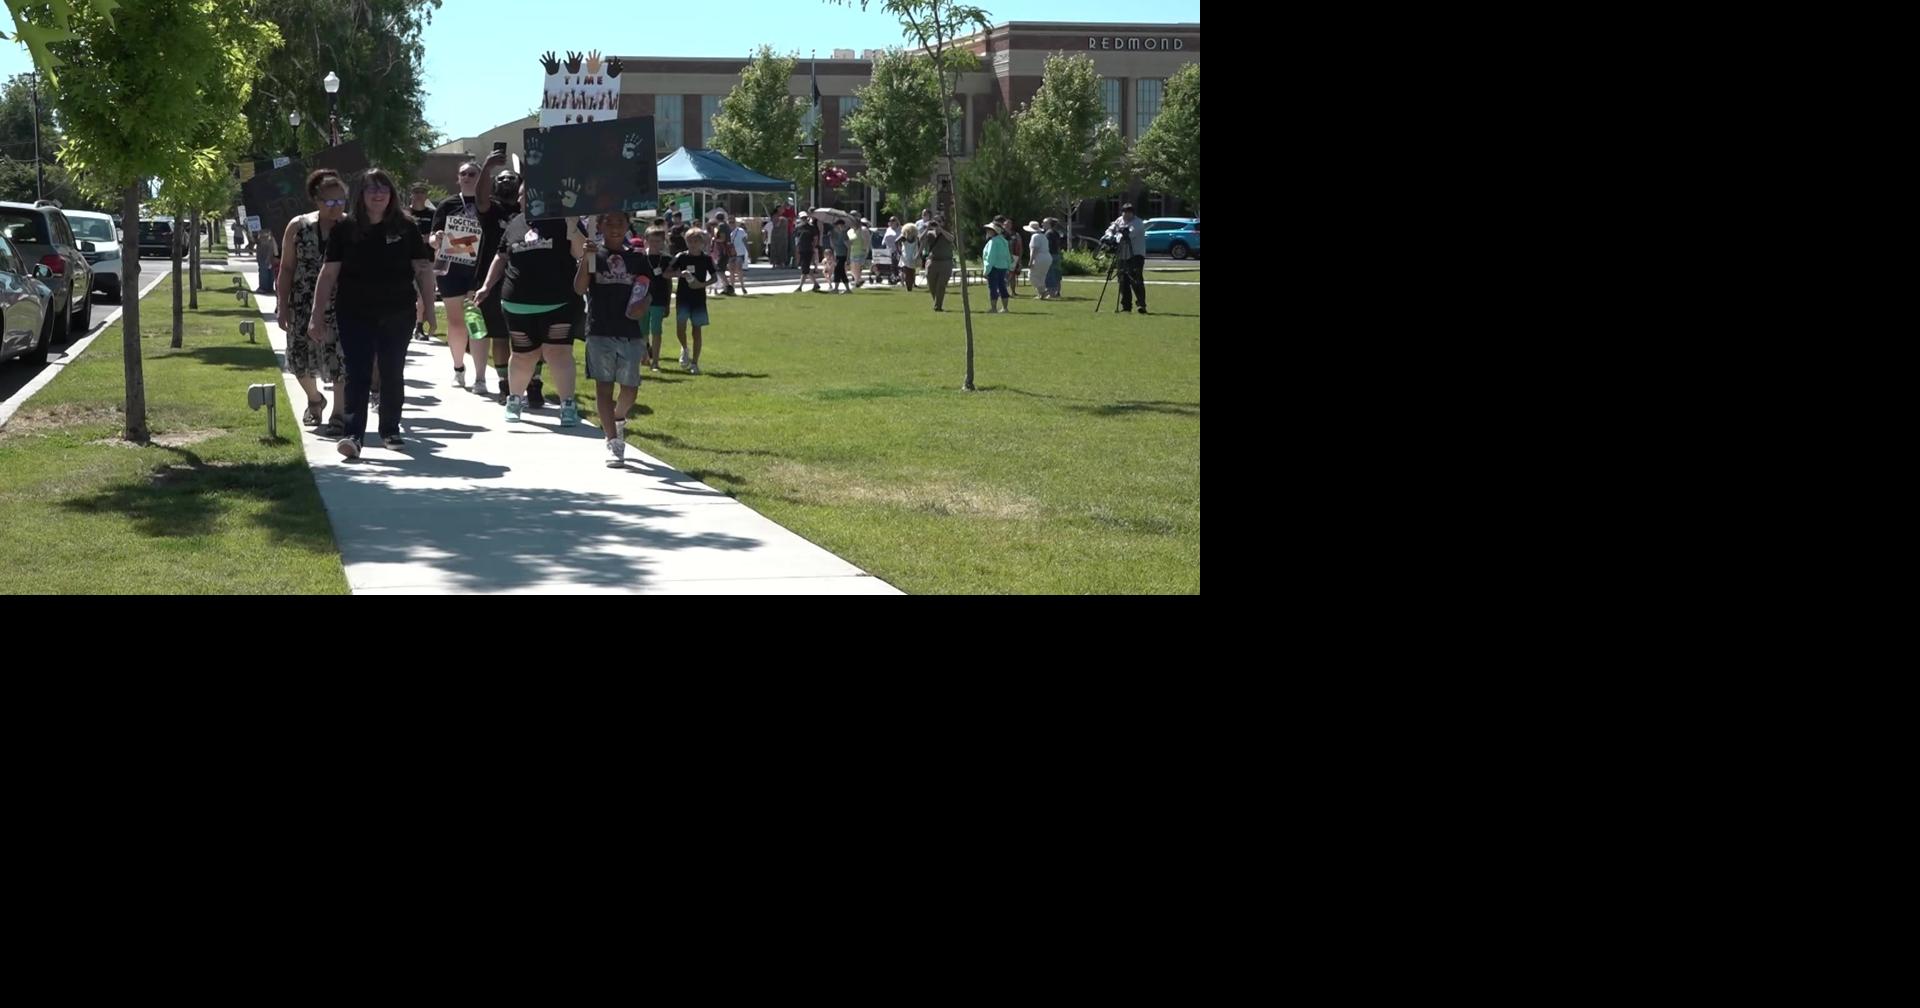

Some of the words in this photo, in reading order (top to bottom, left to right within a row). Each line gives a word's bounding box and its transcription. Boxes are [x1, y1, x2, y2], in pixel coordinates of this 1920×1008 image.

[1089, 37, 1183, 50] REDMOND
[564, 76, 603, 85] TIME
[565, 114, 594, 123] FOR
[461, 226, 482, 235] STAND
